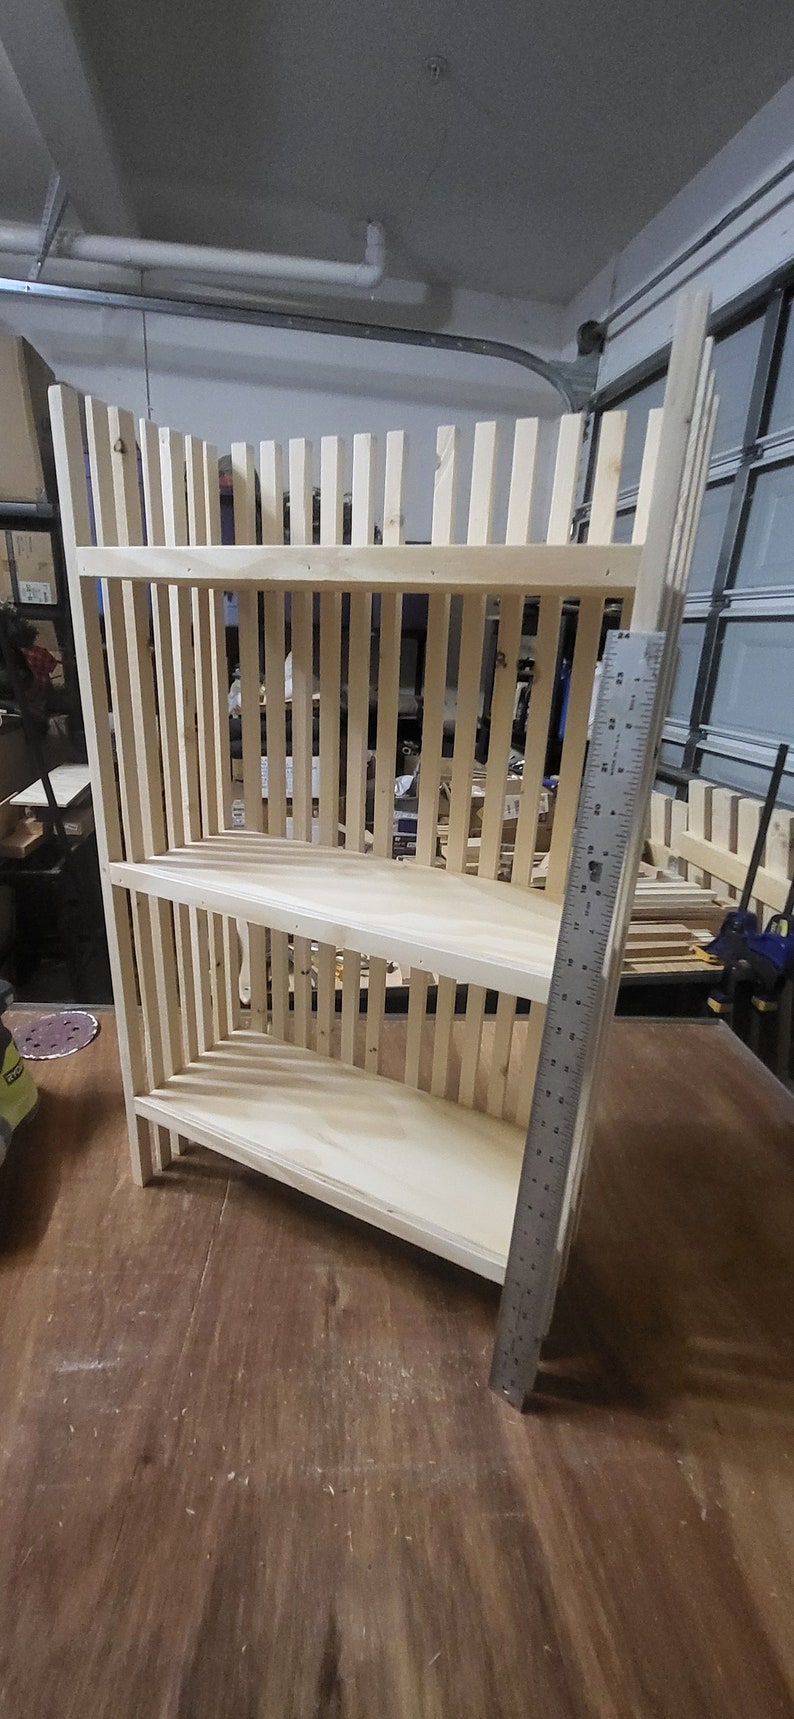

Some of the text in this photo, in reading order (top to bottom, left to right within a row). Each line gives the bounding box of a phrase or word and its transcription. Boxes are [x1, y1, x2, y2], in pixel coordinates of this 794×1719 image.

[616, 672, 624, 685] 23
[608, 718, 616, 730] 22
[601, 762, 608, 772] 21
[594, 804, 601, 816] 20
[574, 922, 580, 930] 17
